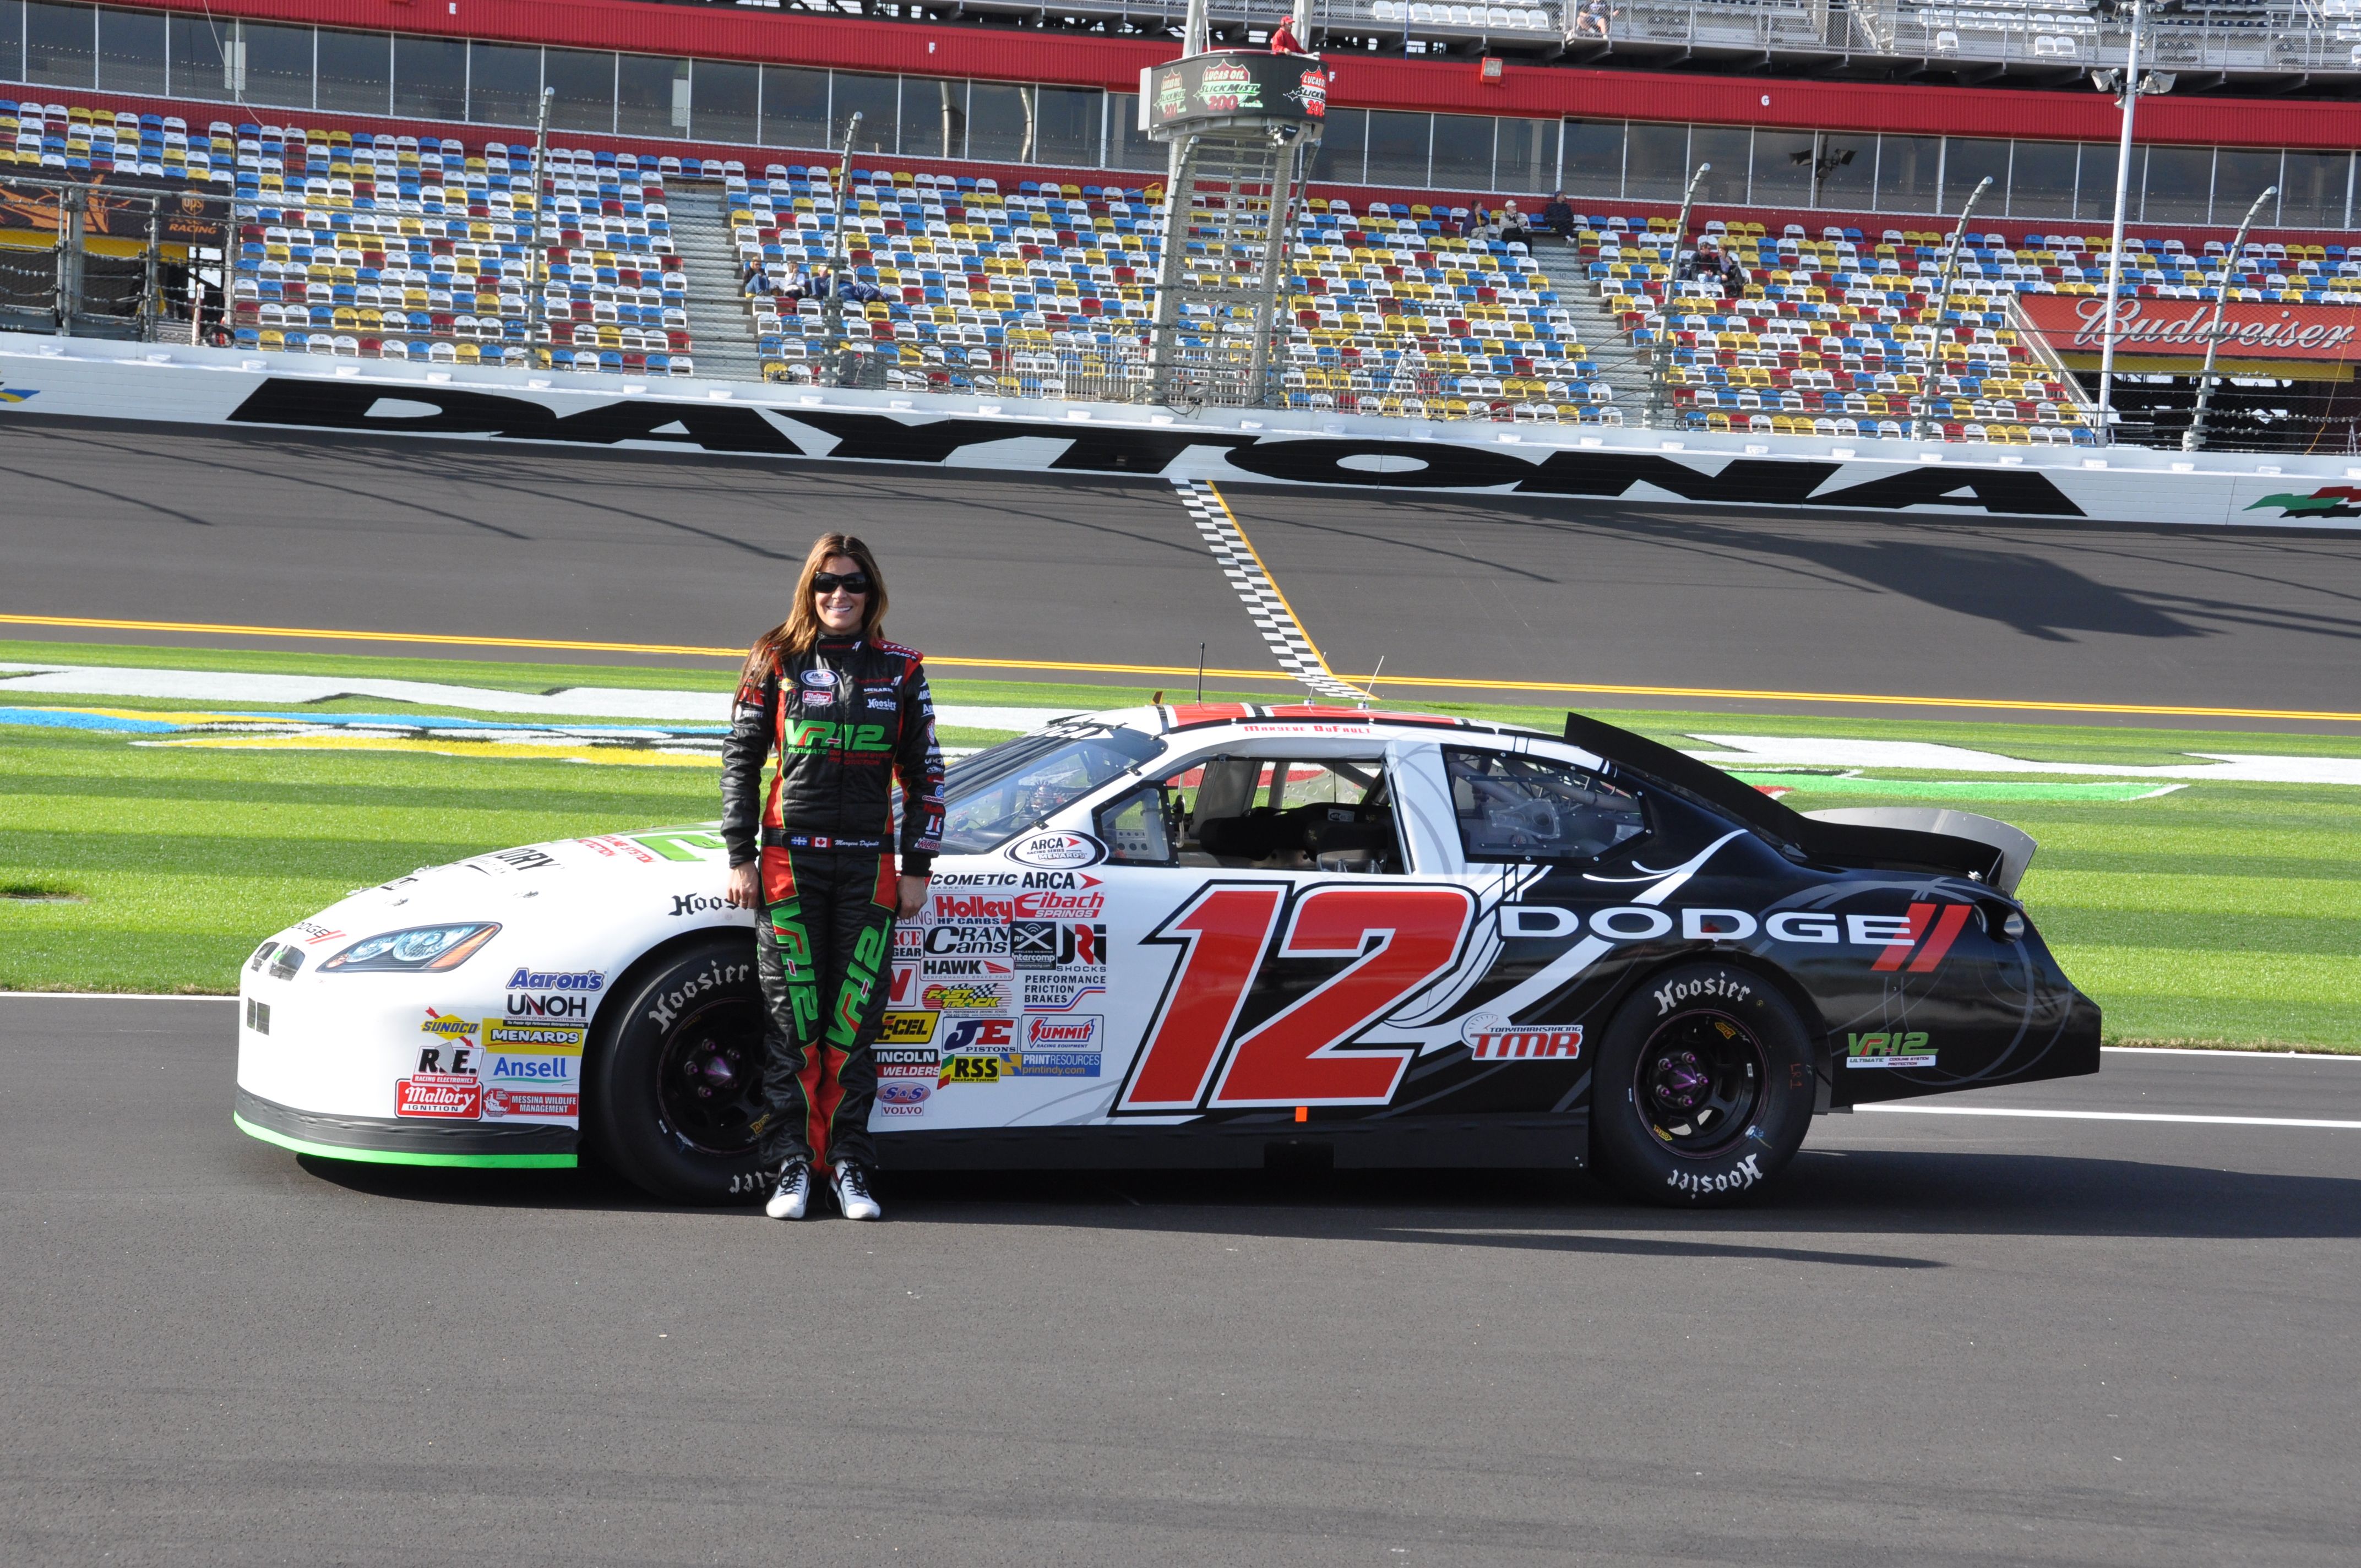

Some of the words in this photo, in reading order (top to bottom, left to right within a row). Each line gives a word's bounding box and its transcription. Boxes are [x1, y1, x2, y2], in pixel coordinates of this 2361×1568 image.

[928, 42, 935, 53] F
[1205, 70, 1229, 81] LUCAS
[1230, 70, 1244, 80] OIL
[1303, 75, 1321, 86] LUCAS
[1329, 72, 1335, 82] F
[1162, 79, 1173, 90] LUCAS
[1200, 84, 1228, 93] SLICK
[1297, 87, 1320, 99] SLICK
[1208, 95, 1238, 111] 200
[1761, 95, 1770, 106] G
[169, 224, 217, 234] RACING
[2073, 298, 2355, 350] Budweiser
[227, 378, 2087, 516] DAYTONA
[917, 690, 931, 701] ARC
[867, 698, 896, 709] Hoosier
[787, 747, 828, 755] ULTIMATE
[1031, 837, 1063, 850] ARCA
[931, 873, 1018, 886] COMETIC
[1021, 872, 1075, 889] ARCA
[668, 892, 751, 917] Hoos
[1015, 891, 1105, 912] Eibach
[935, 896, 1014, 924] Holley
[1035, 910, 1095, 918] SPRINGS
[1499, 906, 1915, 946] DODGE
[893, 948, 922, 957] GEAR
[923, 960, 982, 974] HAWK
[507, 968, 603, 990] Aaron's
[1025, 975, 1106, 984] PERFORMANCE
[926, 989, 973, 999] FAST
[1025, 985, 1074, 993] FRICTION
[1653, 971, 1750, 1016] Hoosier
[649, 960, 749, 1035] Hoosier
[942, 997, 1002, 1008] TRACK
[1024, 994, 1068, 1003] BRAKES
[1115, 883, 1476, 1112] 12
[507, 993, 586, 1017] UNOH
[421, 1021, 479, 1033] SUNOCO
[491, 1029, 579, 1044] MENARDS
[944, 1020, 1014, 1051] JE
[1470, 1032, 1581, 1058] TMR
[875, 1052, 935, 1063] INCOLN
[1023, 1054, 1100, 1065] PRINTRESOURCES
[493, 1057, 567, 1077] Ansell
[883, 1066, 940, 1076] WELDERS
[954, 1058, 998, 1078] RSS
[1022, 1066, 1085, 1075] printindy.com
[405, 1086, 476, 1107] Mallory
[512, 1095, 543, 1104] MESSINA
[545, 1096, 576, 1105] WILDLIFE
[519, 1104, 568, 1113] MANAGEMENT
[883, 1107, 922, 1115] VOLVO
[1667, 1153, 1764, 1200] Hoosier
